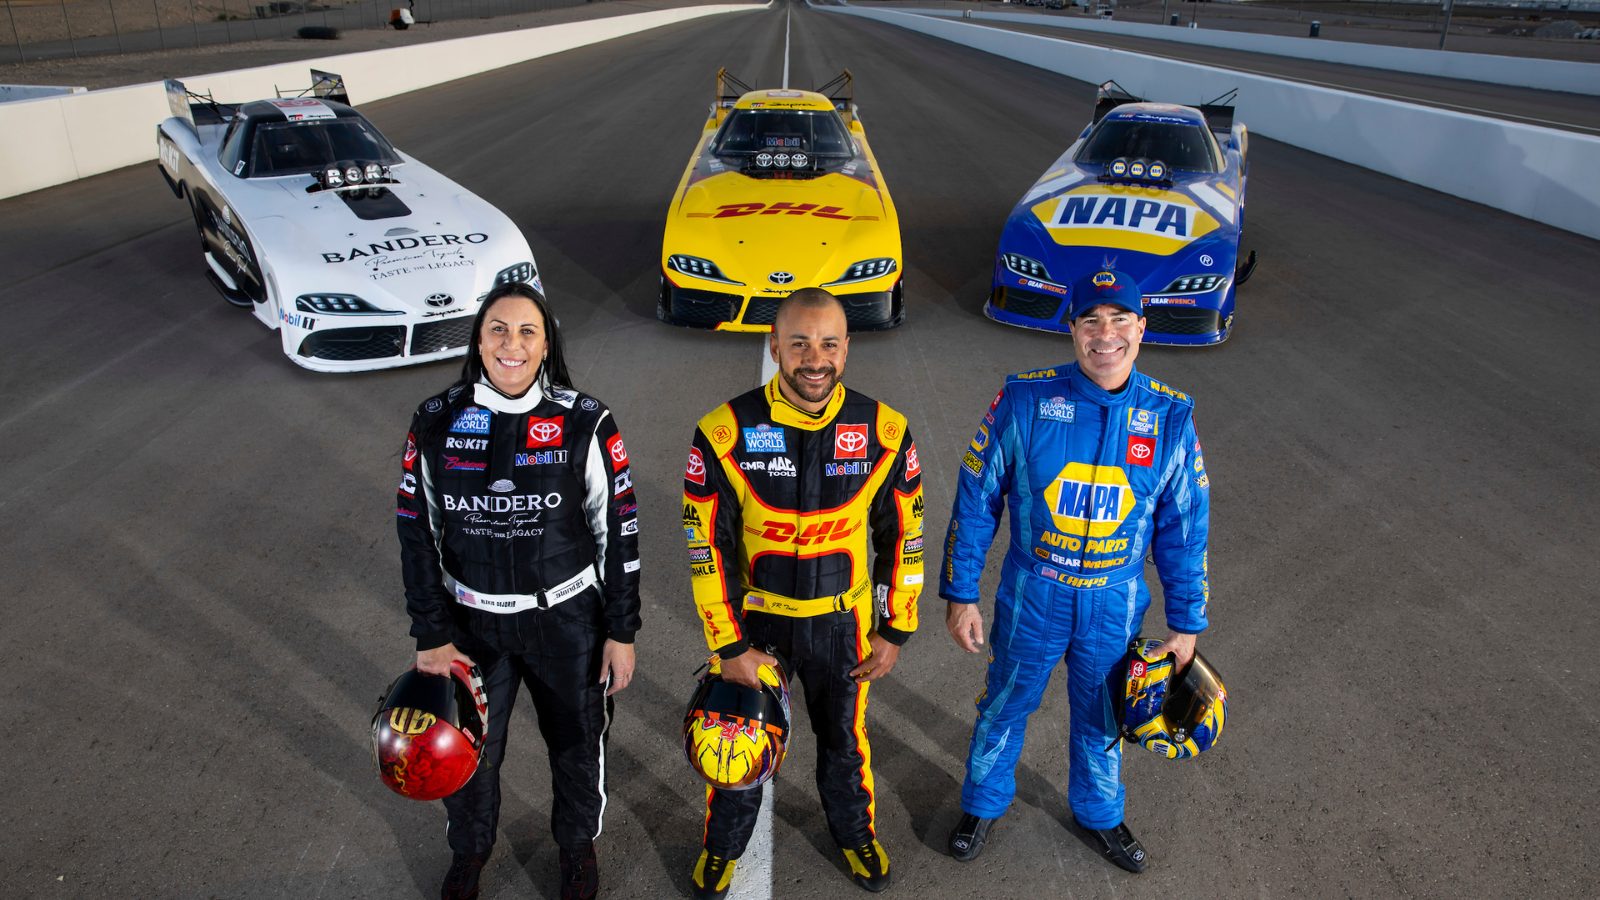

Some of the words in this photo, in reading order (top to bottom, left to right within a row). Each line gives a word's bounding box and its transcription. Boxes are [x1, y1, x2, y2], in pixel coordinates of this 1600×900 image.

[712, 202, 853, 221] DHL
[1058, 196, 1187, 237] NAPA
[321, 232, 489, 264] BANDERO
[369, 267, 412, 281] TASTE
[427, 259, 476, 271] LEGACY
[279, 308, 301, 327] Mobil
[1040, 402, 1075, 412] CAMPING
[1040, 408, 1074, 419] WORLD
[452, 420, 489, 430] WORLD
[454, 413, 489, 422] AMPING
[745, 432, 782, 440] CAMPING
[746, 439, 784, 449] WORLD
[515, 451, 553, 467] Mobil
[739, 461, 766, 471] CMR
[767, 456, 796, 472] MAC
[825, 462, 860, 477] Mobil
[443, 492, 562, 513] BANDERO
[1057, 480, 1121, 521] NAPA
[682, 503, 700, 521] AC
[462, 528, 493, 537] TASTE
[506, 528, 544, 539] LEGACY
[760, 517, 853, 546] DHL
[1040, 530, 1082, 552] AUTO
[1084, 538, 1129, 554] PARTS
[692, 564, 717, 577] AHLE
[1058, 573, 1108, 588] CAPPS
